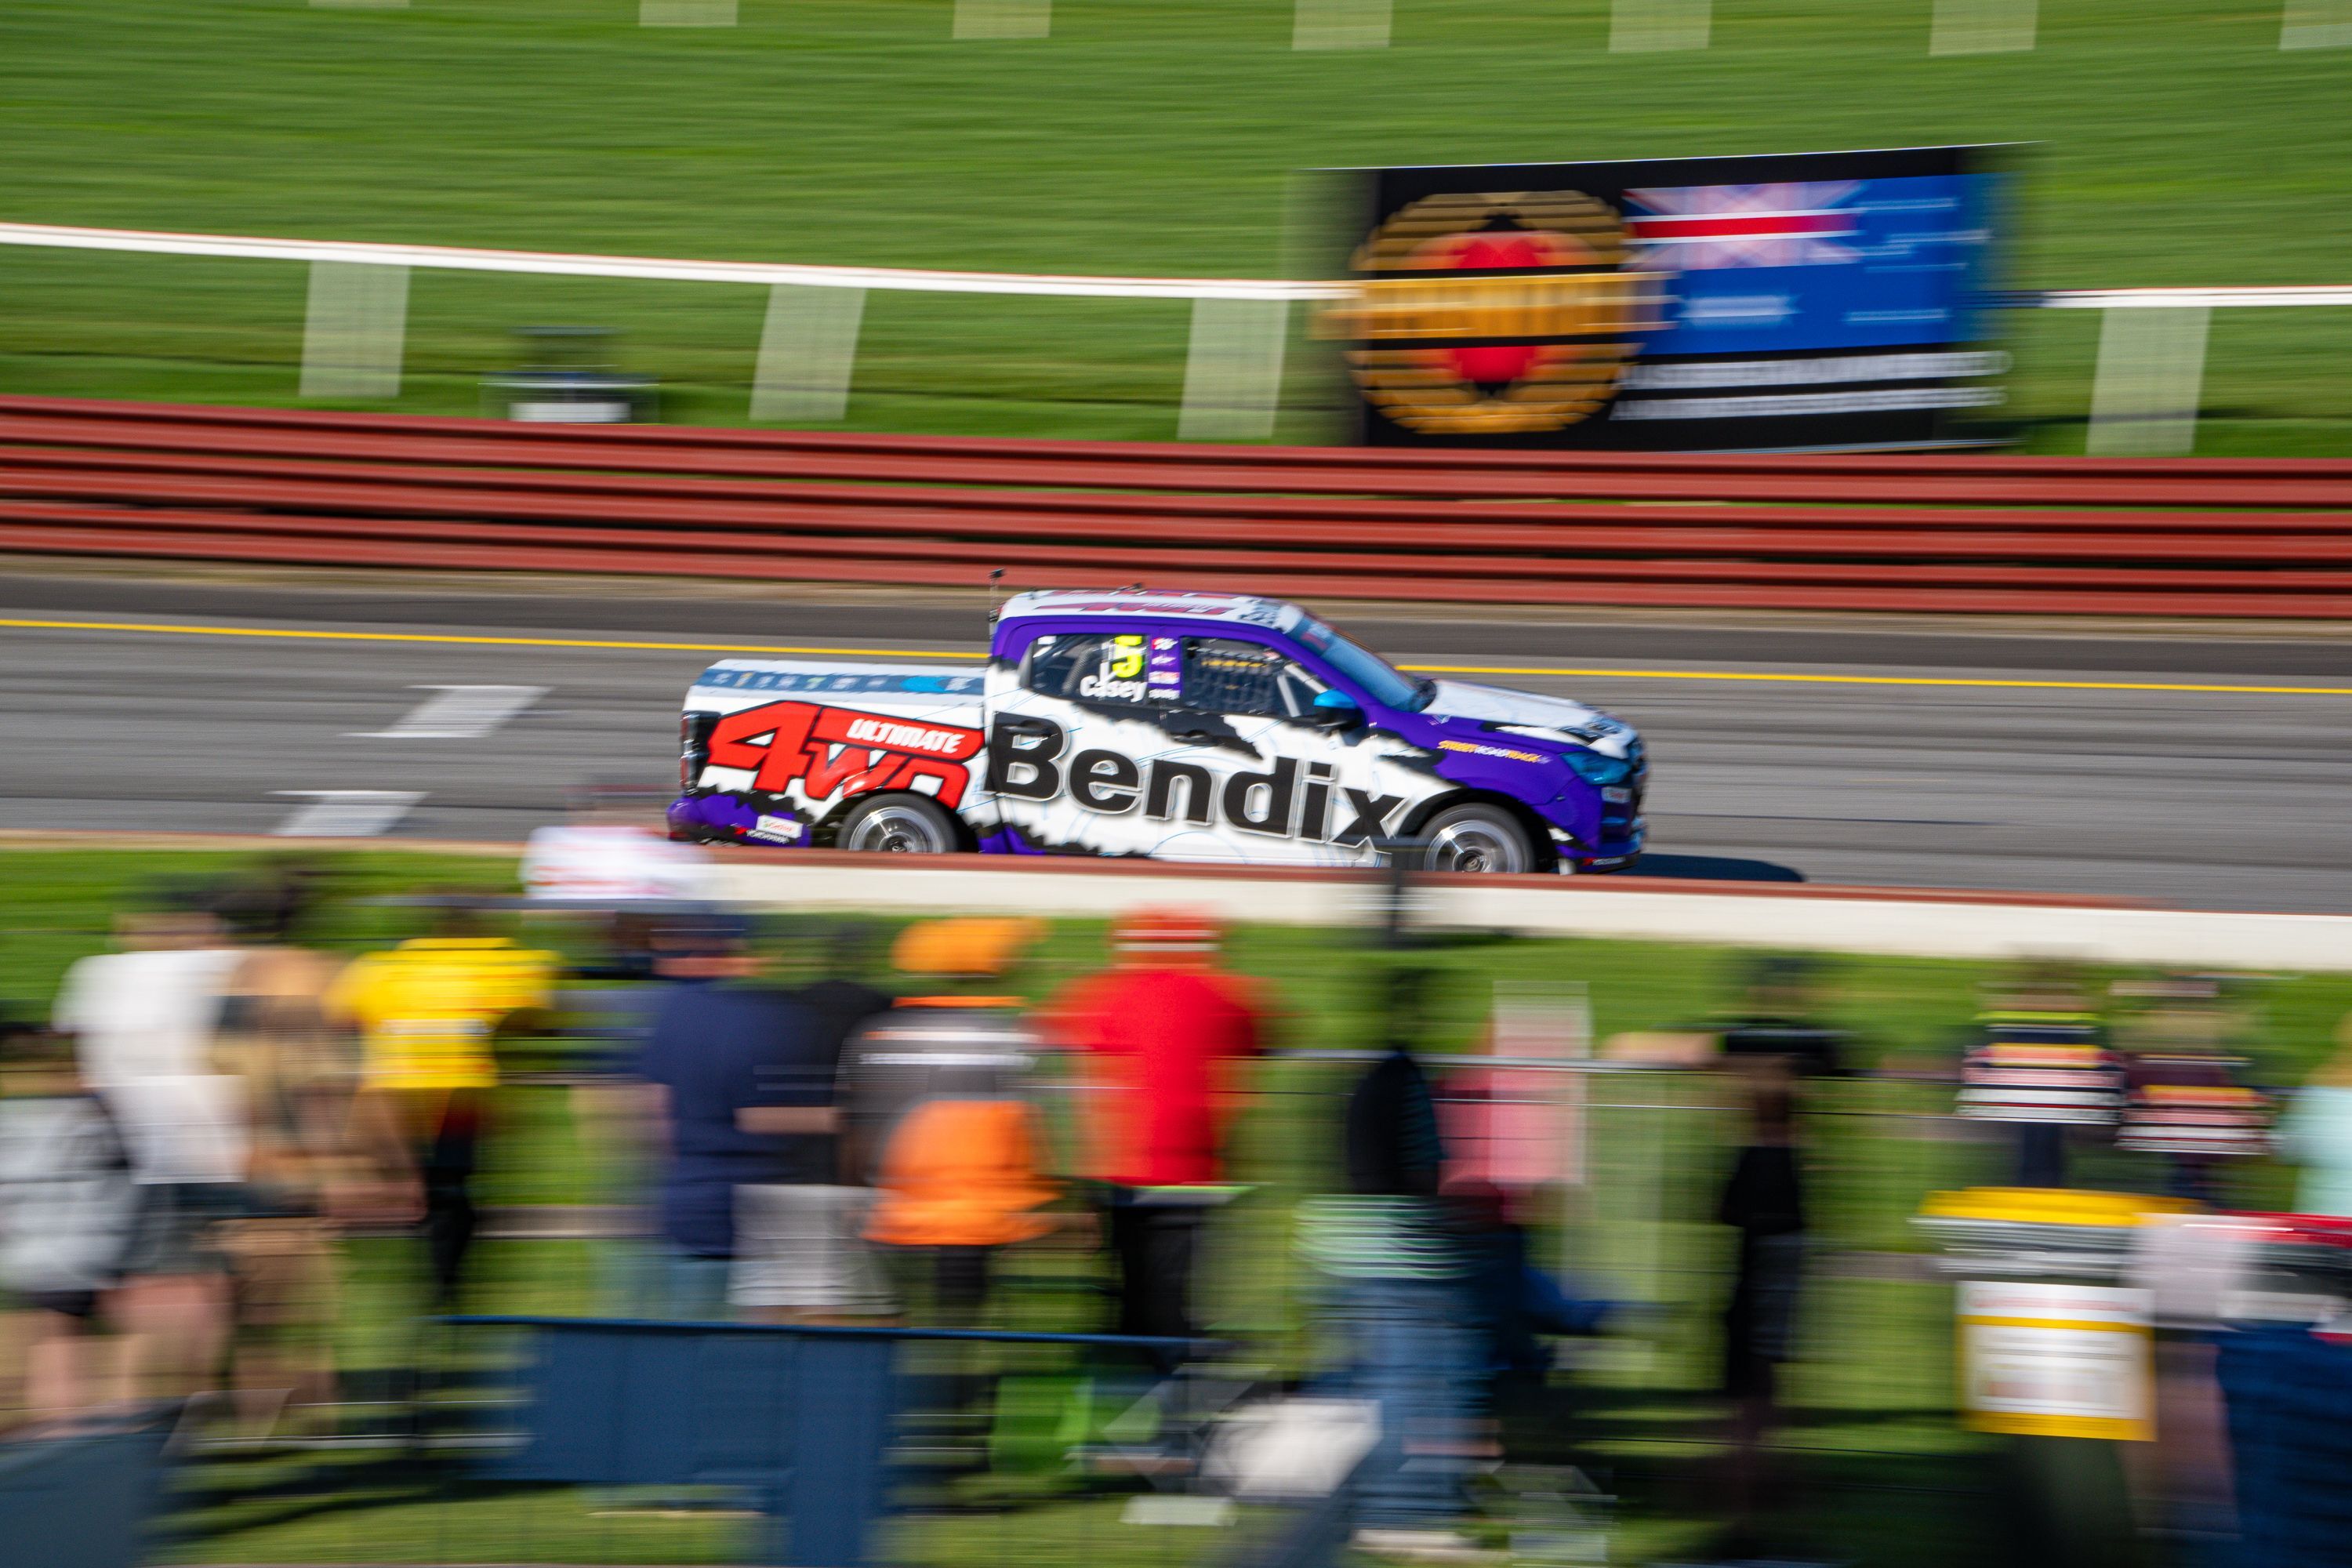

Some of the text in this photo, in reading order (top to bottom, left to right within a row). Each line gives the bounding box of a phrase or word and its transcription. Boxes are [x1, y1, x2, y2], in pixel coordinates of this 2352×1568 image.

[1112, 635, 1143, 678] 5
[1080, 674, 1149, 702] Casey
[845, 717, 966, 753] ULTIMATE
[985, 710, 1410, 849] Bendix
